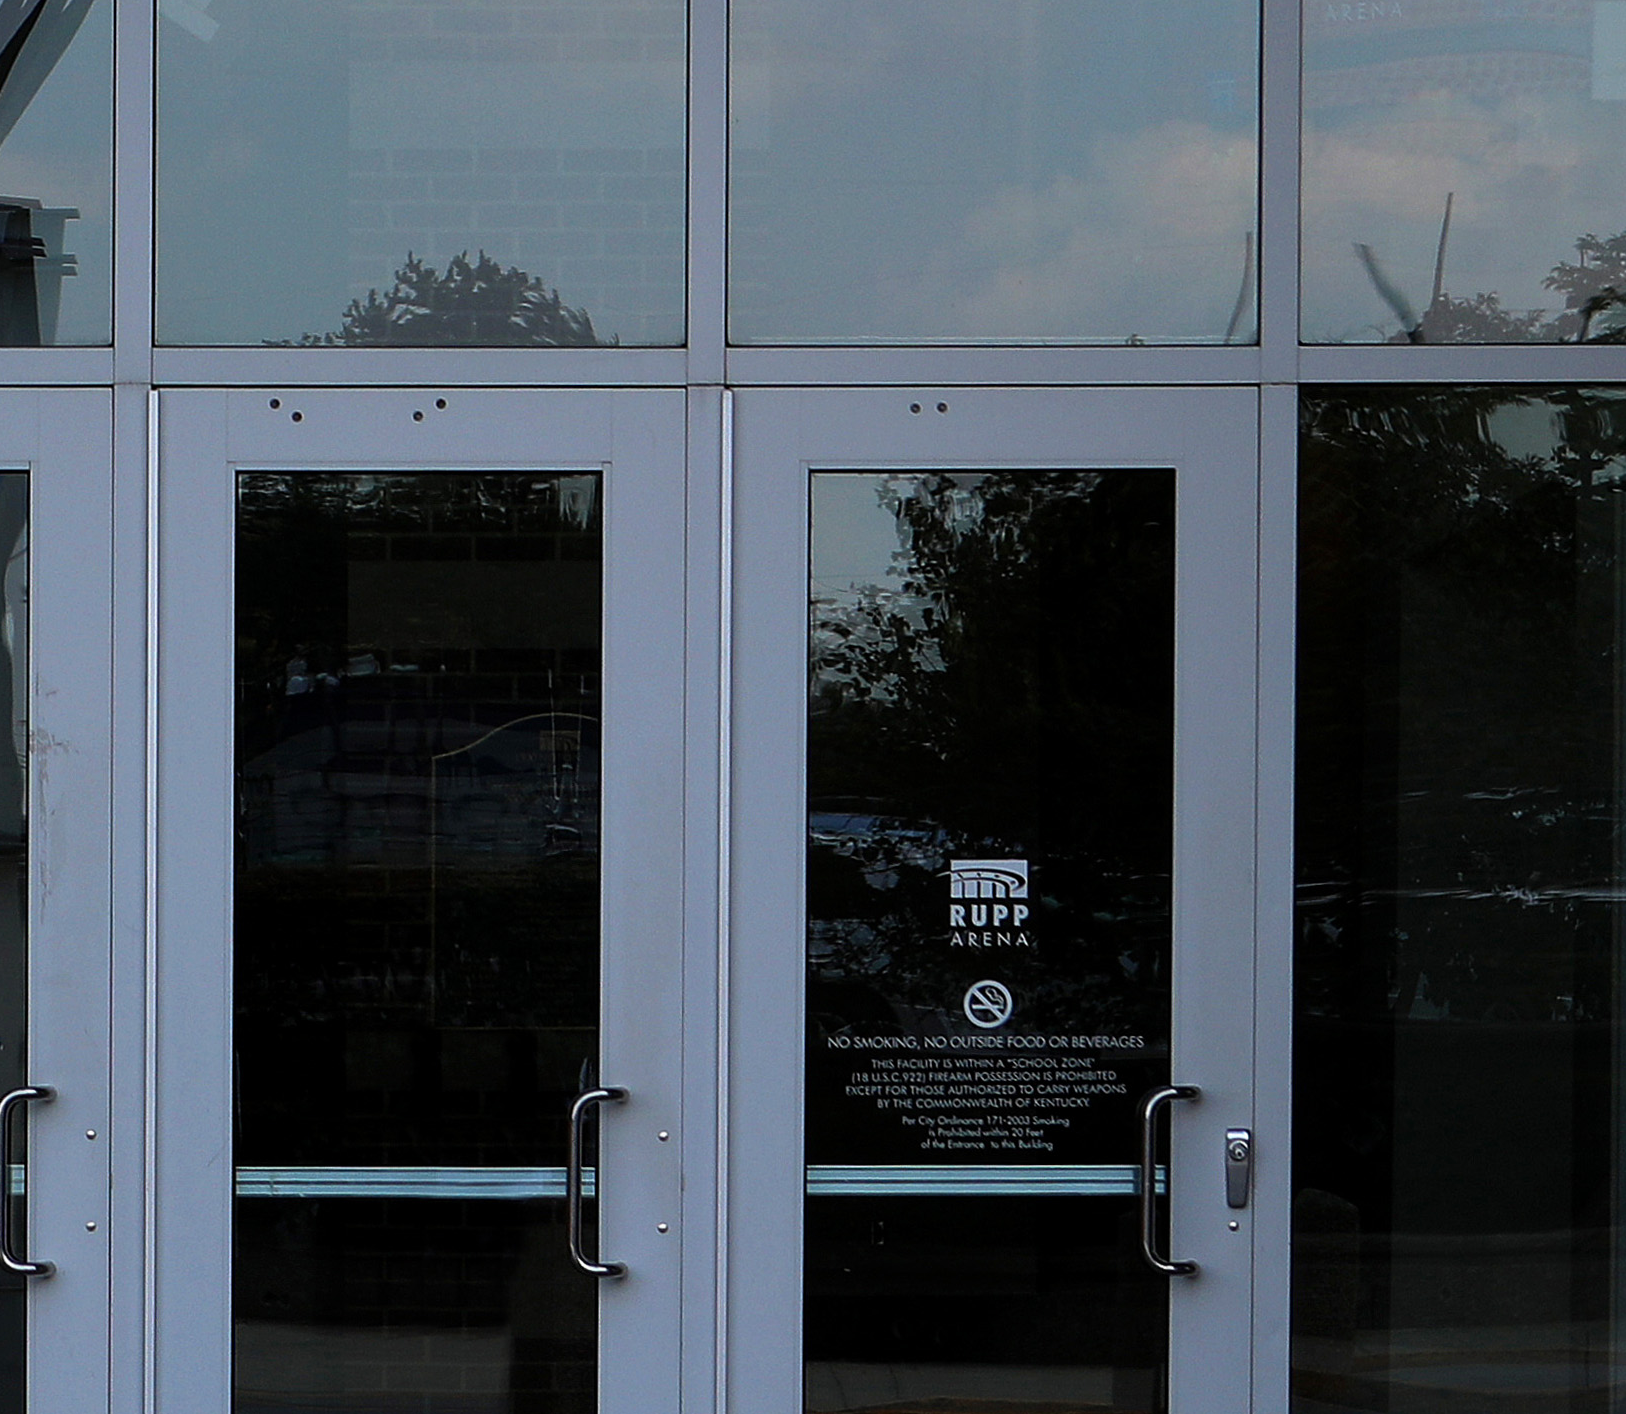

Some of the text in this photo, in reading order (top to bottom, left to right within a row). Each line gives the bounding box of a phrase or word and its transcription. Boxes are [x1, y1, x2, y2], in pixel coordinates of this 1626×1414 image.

[1323, 1, 1404, 22] ARENA
[951, 905, 1028, 926] RUPP
[951, 932, 1029, 947] ARENA
[827, 1035, 852, 1049] NO
[853, 1035, 921, 1051] SMOKING,
[923, 1035, 948, 1049] NO
[949, 1035, 1004, 1049] OUTSIDE
[1007, 1035, 1047, 1049] FOOD
[1048, 1035, 1069, 1049] OR
[871, 1058, 895, 1070] THIS
[896, 1058, 941, 1070] FACILITY
[942, 1058, 953, 1069] IS
[953, 1058, 995, 1069] WITHIN
[995, 1059, 1006, 1069] A
[1006, 1057, 1059, 1069] "SCHOOL
[851, 1072, 870, 1084] (18
[928, 1071, 973, 1083] FIREARM
[974, 1070, 1041, 1082] POSSESSION
[1042, 1070, 1054, 1082] IS
[1055, 1070, 1117, 1082] PROHIBITED
[845, 1083, 1127, 1096] EXCEPT FOR THOSE AUTHORIZED TO CARRY WEAPONS
[876, 1098, 891, 1109] BY
[892, 1098, 913, 1109] THE
[915, 1097, 1013, 1109] COMMONWEALTH
[1014, 1097, 1031, 1108] OF
